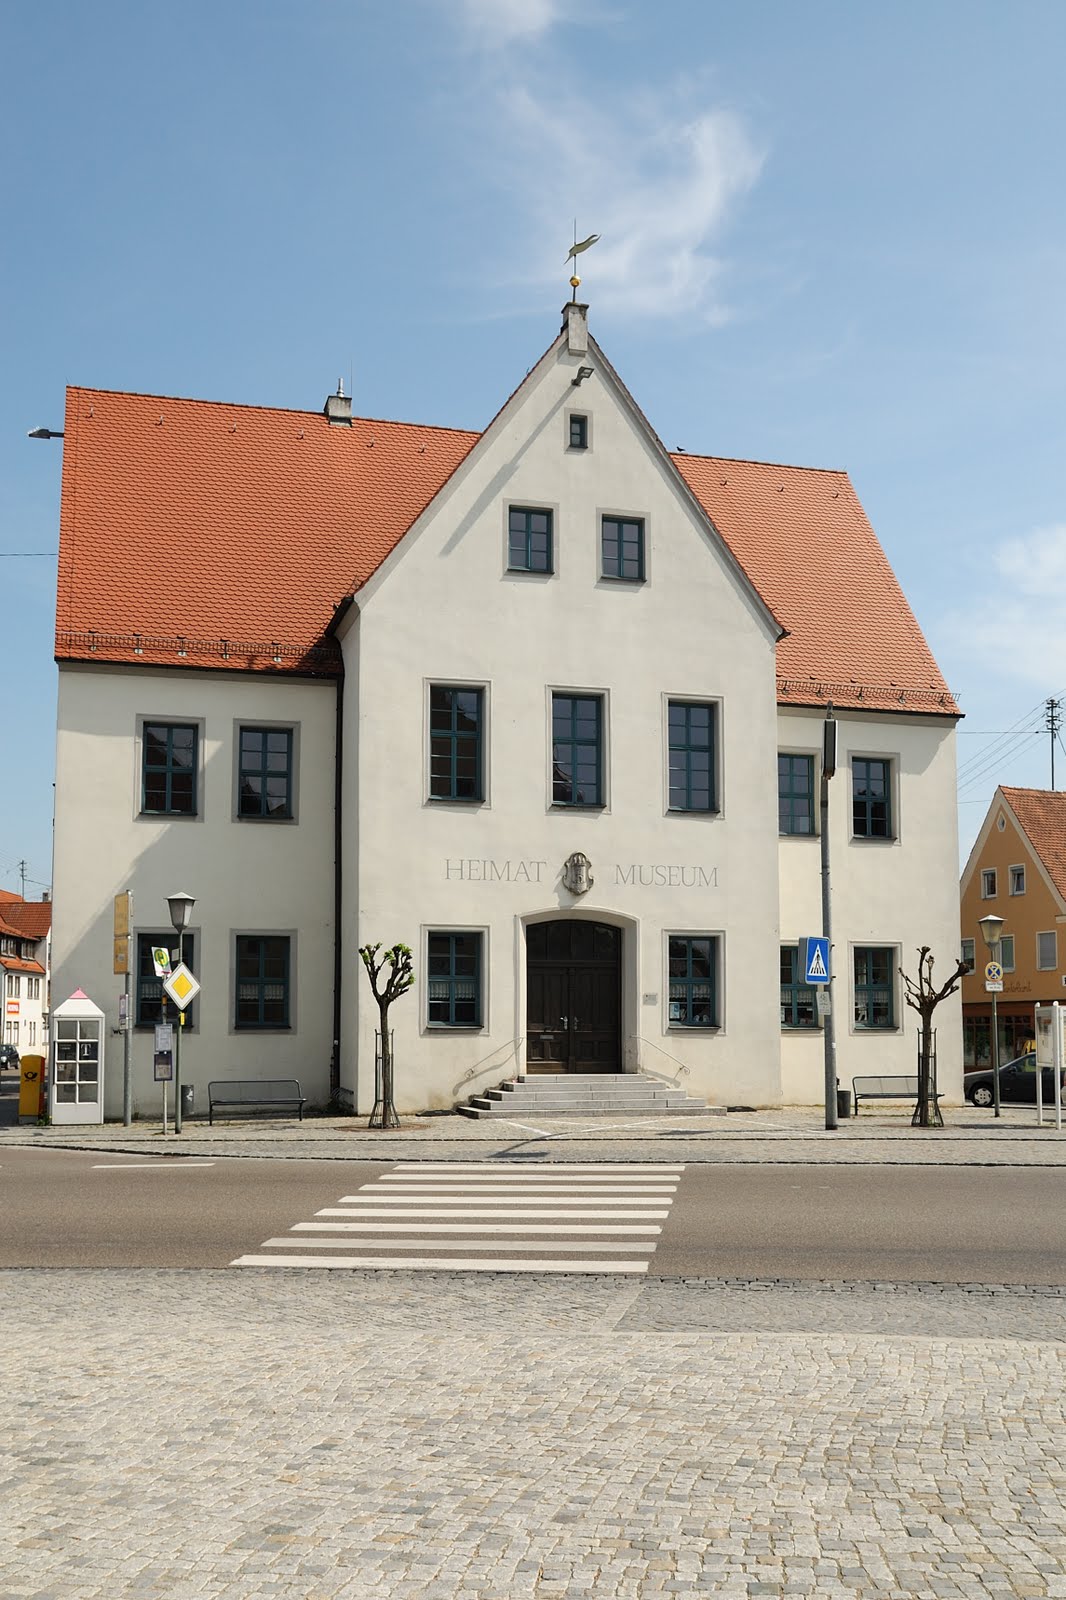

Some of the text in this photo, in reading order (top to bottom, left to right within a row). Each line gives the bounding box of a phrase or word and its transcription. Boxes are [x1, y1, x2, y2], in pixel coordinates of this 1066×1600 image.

[445, 859, 719, 887] HEIMAT MUSEUM
[81, 1044, 91, 1056] T
